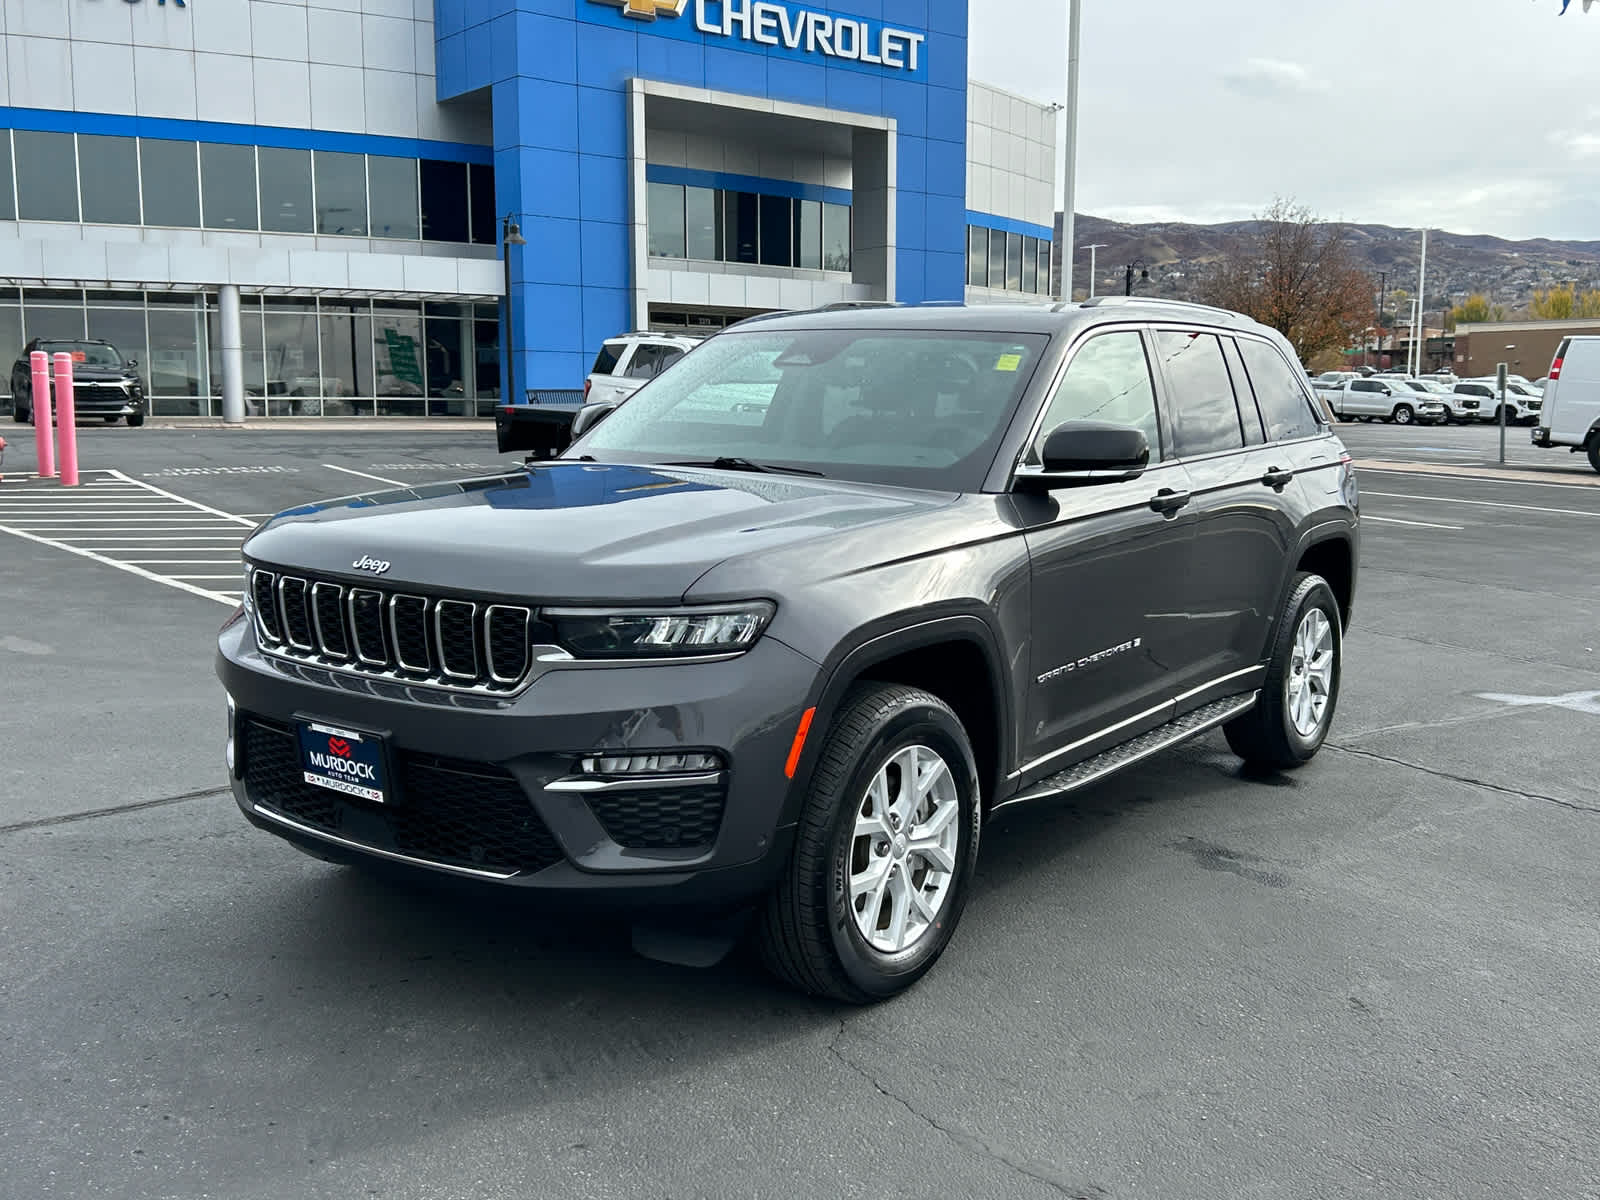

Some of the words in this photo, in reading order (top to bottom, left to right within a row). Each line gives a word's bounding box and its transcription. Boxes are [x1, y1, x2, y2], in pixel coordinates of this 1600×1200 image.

[696, 0, 924, 70] CHEVROLET
[352, 554, 391, 574] Jeep
[1037, 662, 1075, 683] GRAND
[1077, 641, 1132, 667] CHEROKEE
[310, 750, 376, 780] MURDOCK
[328, 770, 342, 779] AUTO
[344, 773, 359, 783] TEAM
[321, 779, 365, 796] MURDOCK
